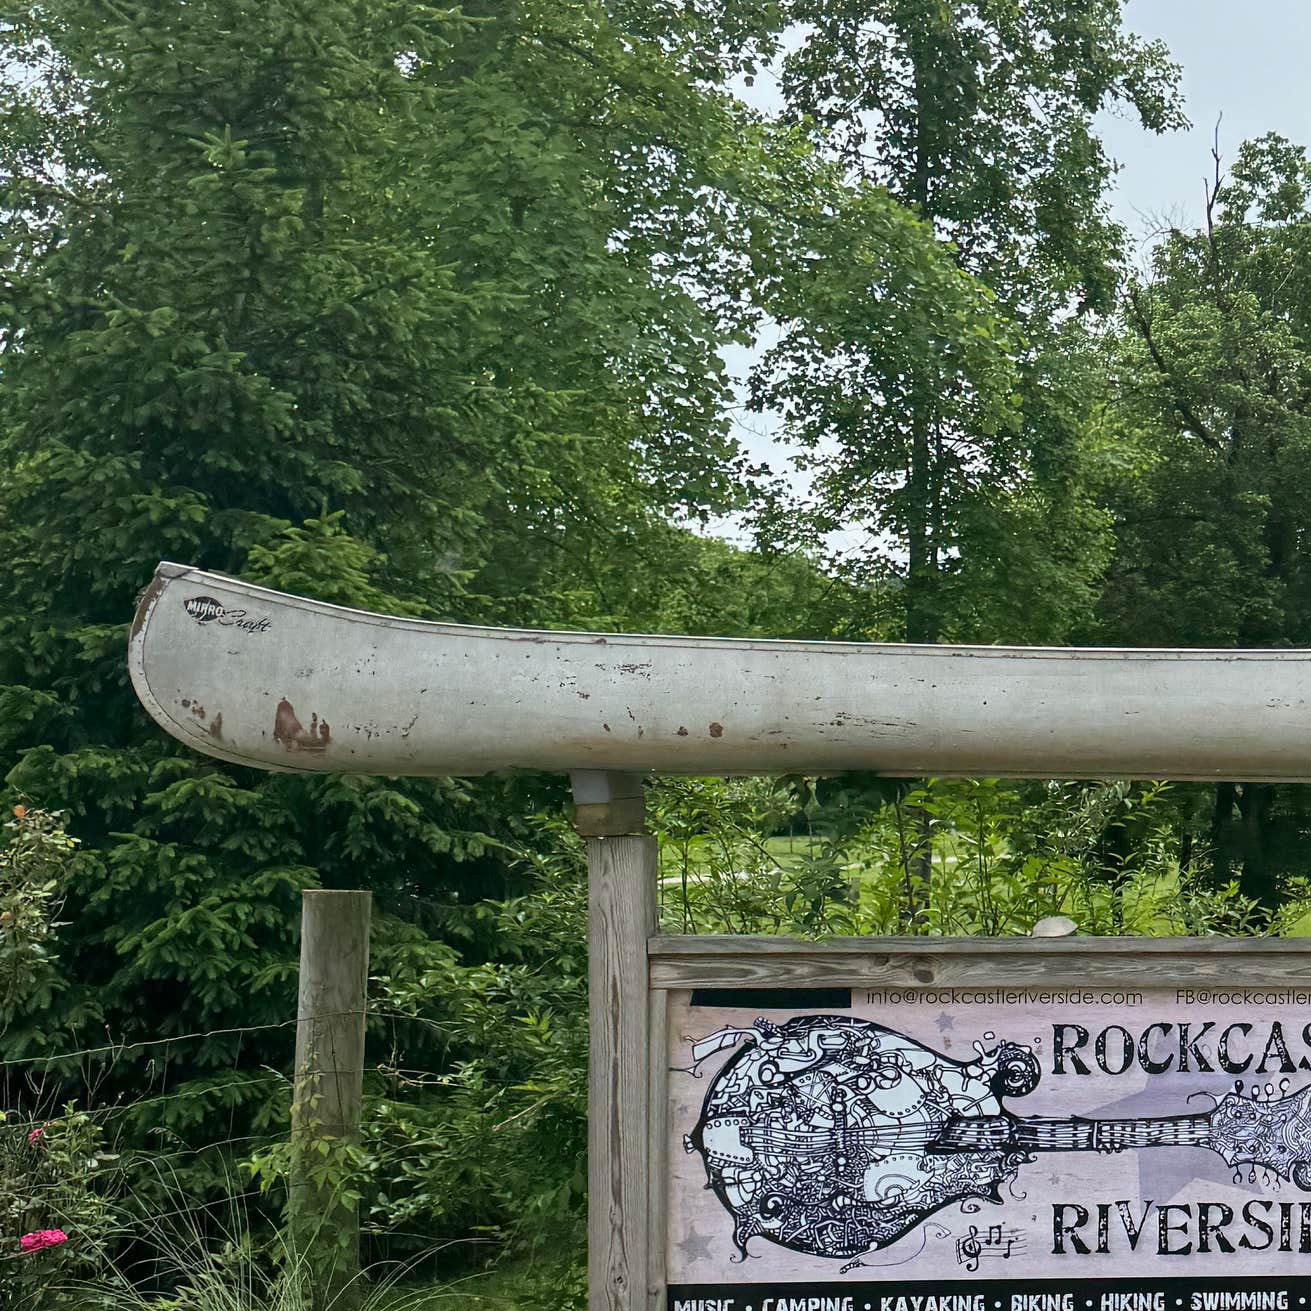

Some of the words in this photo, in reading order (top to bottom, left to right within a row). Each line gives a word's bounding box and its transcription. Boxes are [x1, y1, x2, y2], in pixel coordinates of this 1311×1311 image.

[218, 609, 273, 633] Craft
[866, 988, 1143, 1005] info@rockcastleriverside.com
[1190, 1290, 1289, 1311] SWIMMING
